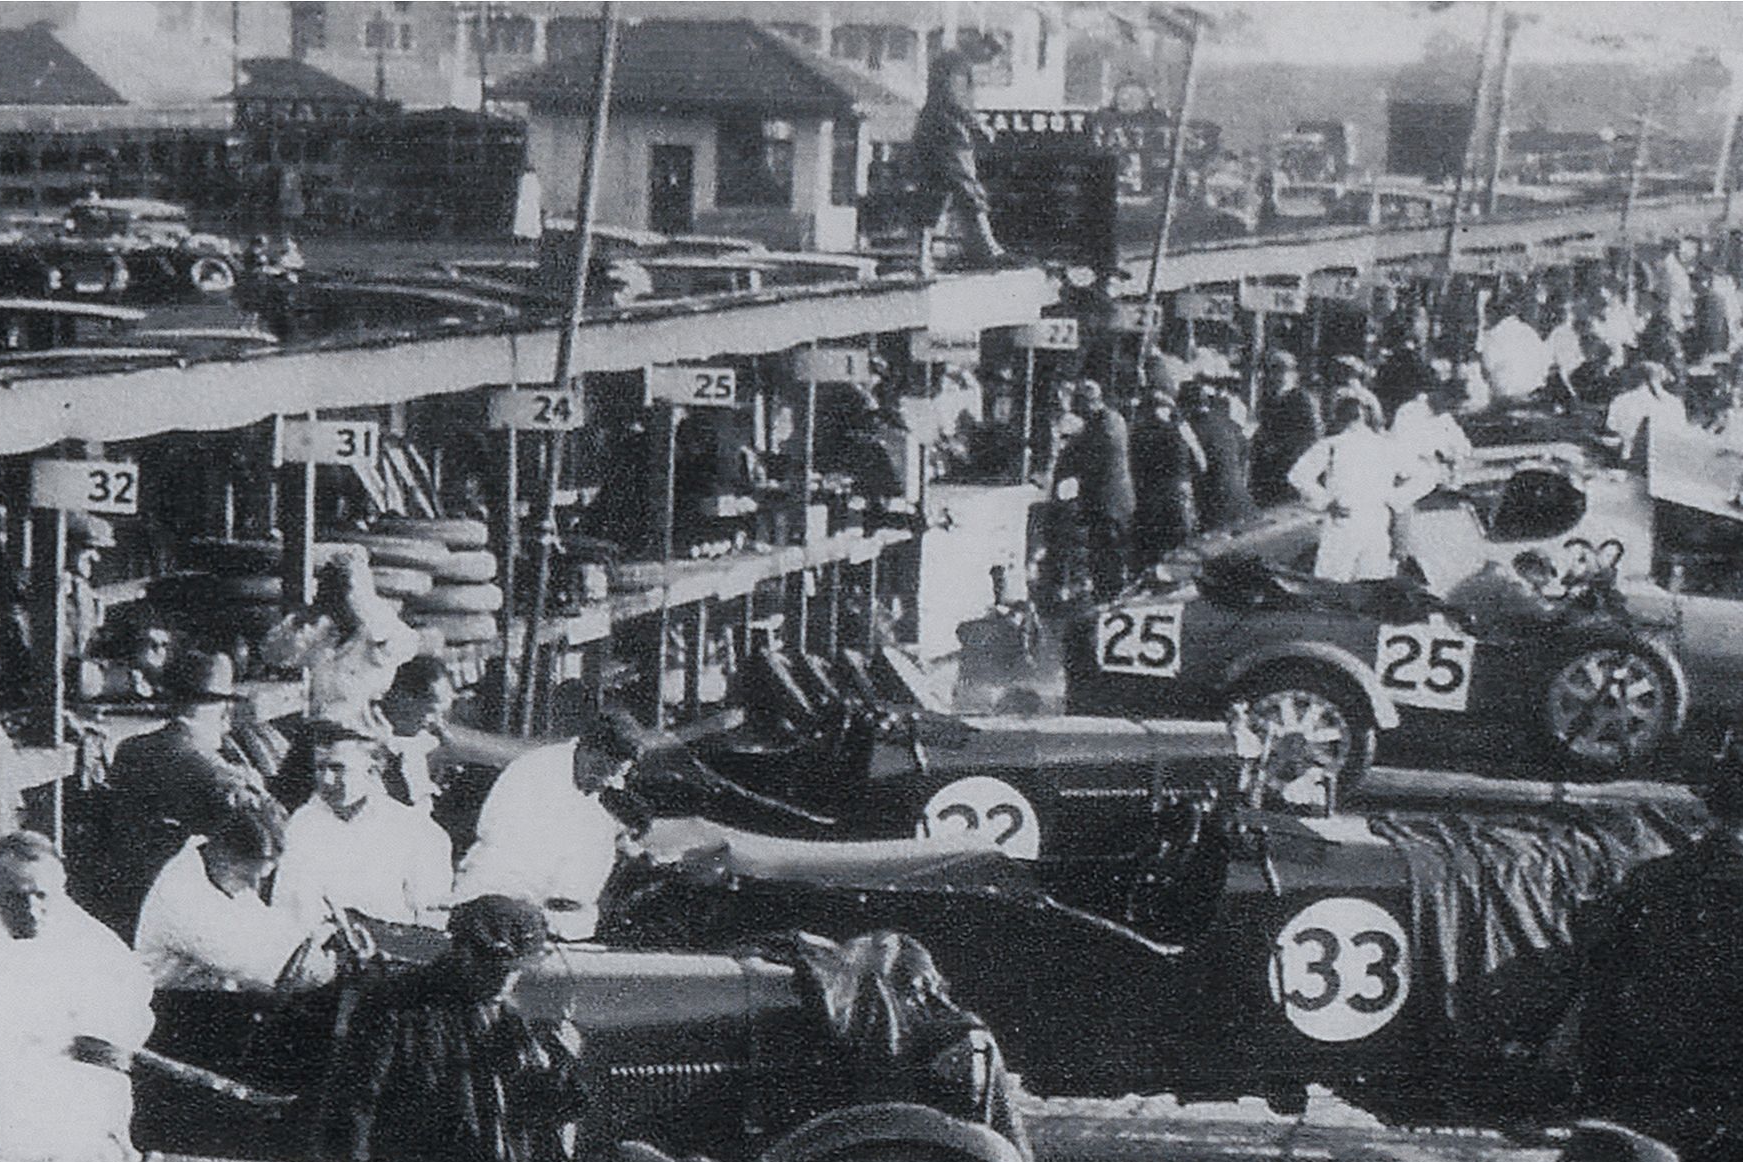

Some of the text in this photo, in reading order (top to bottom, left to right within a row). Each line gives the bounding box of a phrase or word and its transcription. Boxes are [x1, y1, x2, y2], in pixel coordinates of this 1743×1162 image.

[694, 373, 731, 400] 25
[534, 394, 572, 424] 24
[336, 428, 372, 458] 31
[87, 469, 133, 503] 32
[1102, 612, 1177, 669] 25
[1379, 633, 1464, 693] 25
[1290, 927, 1402, 1014] 33
